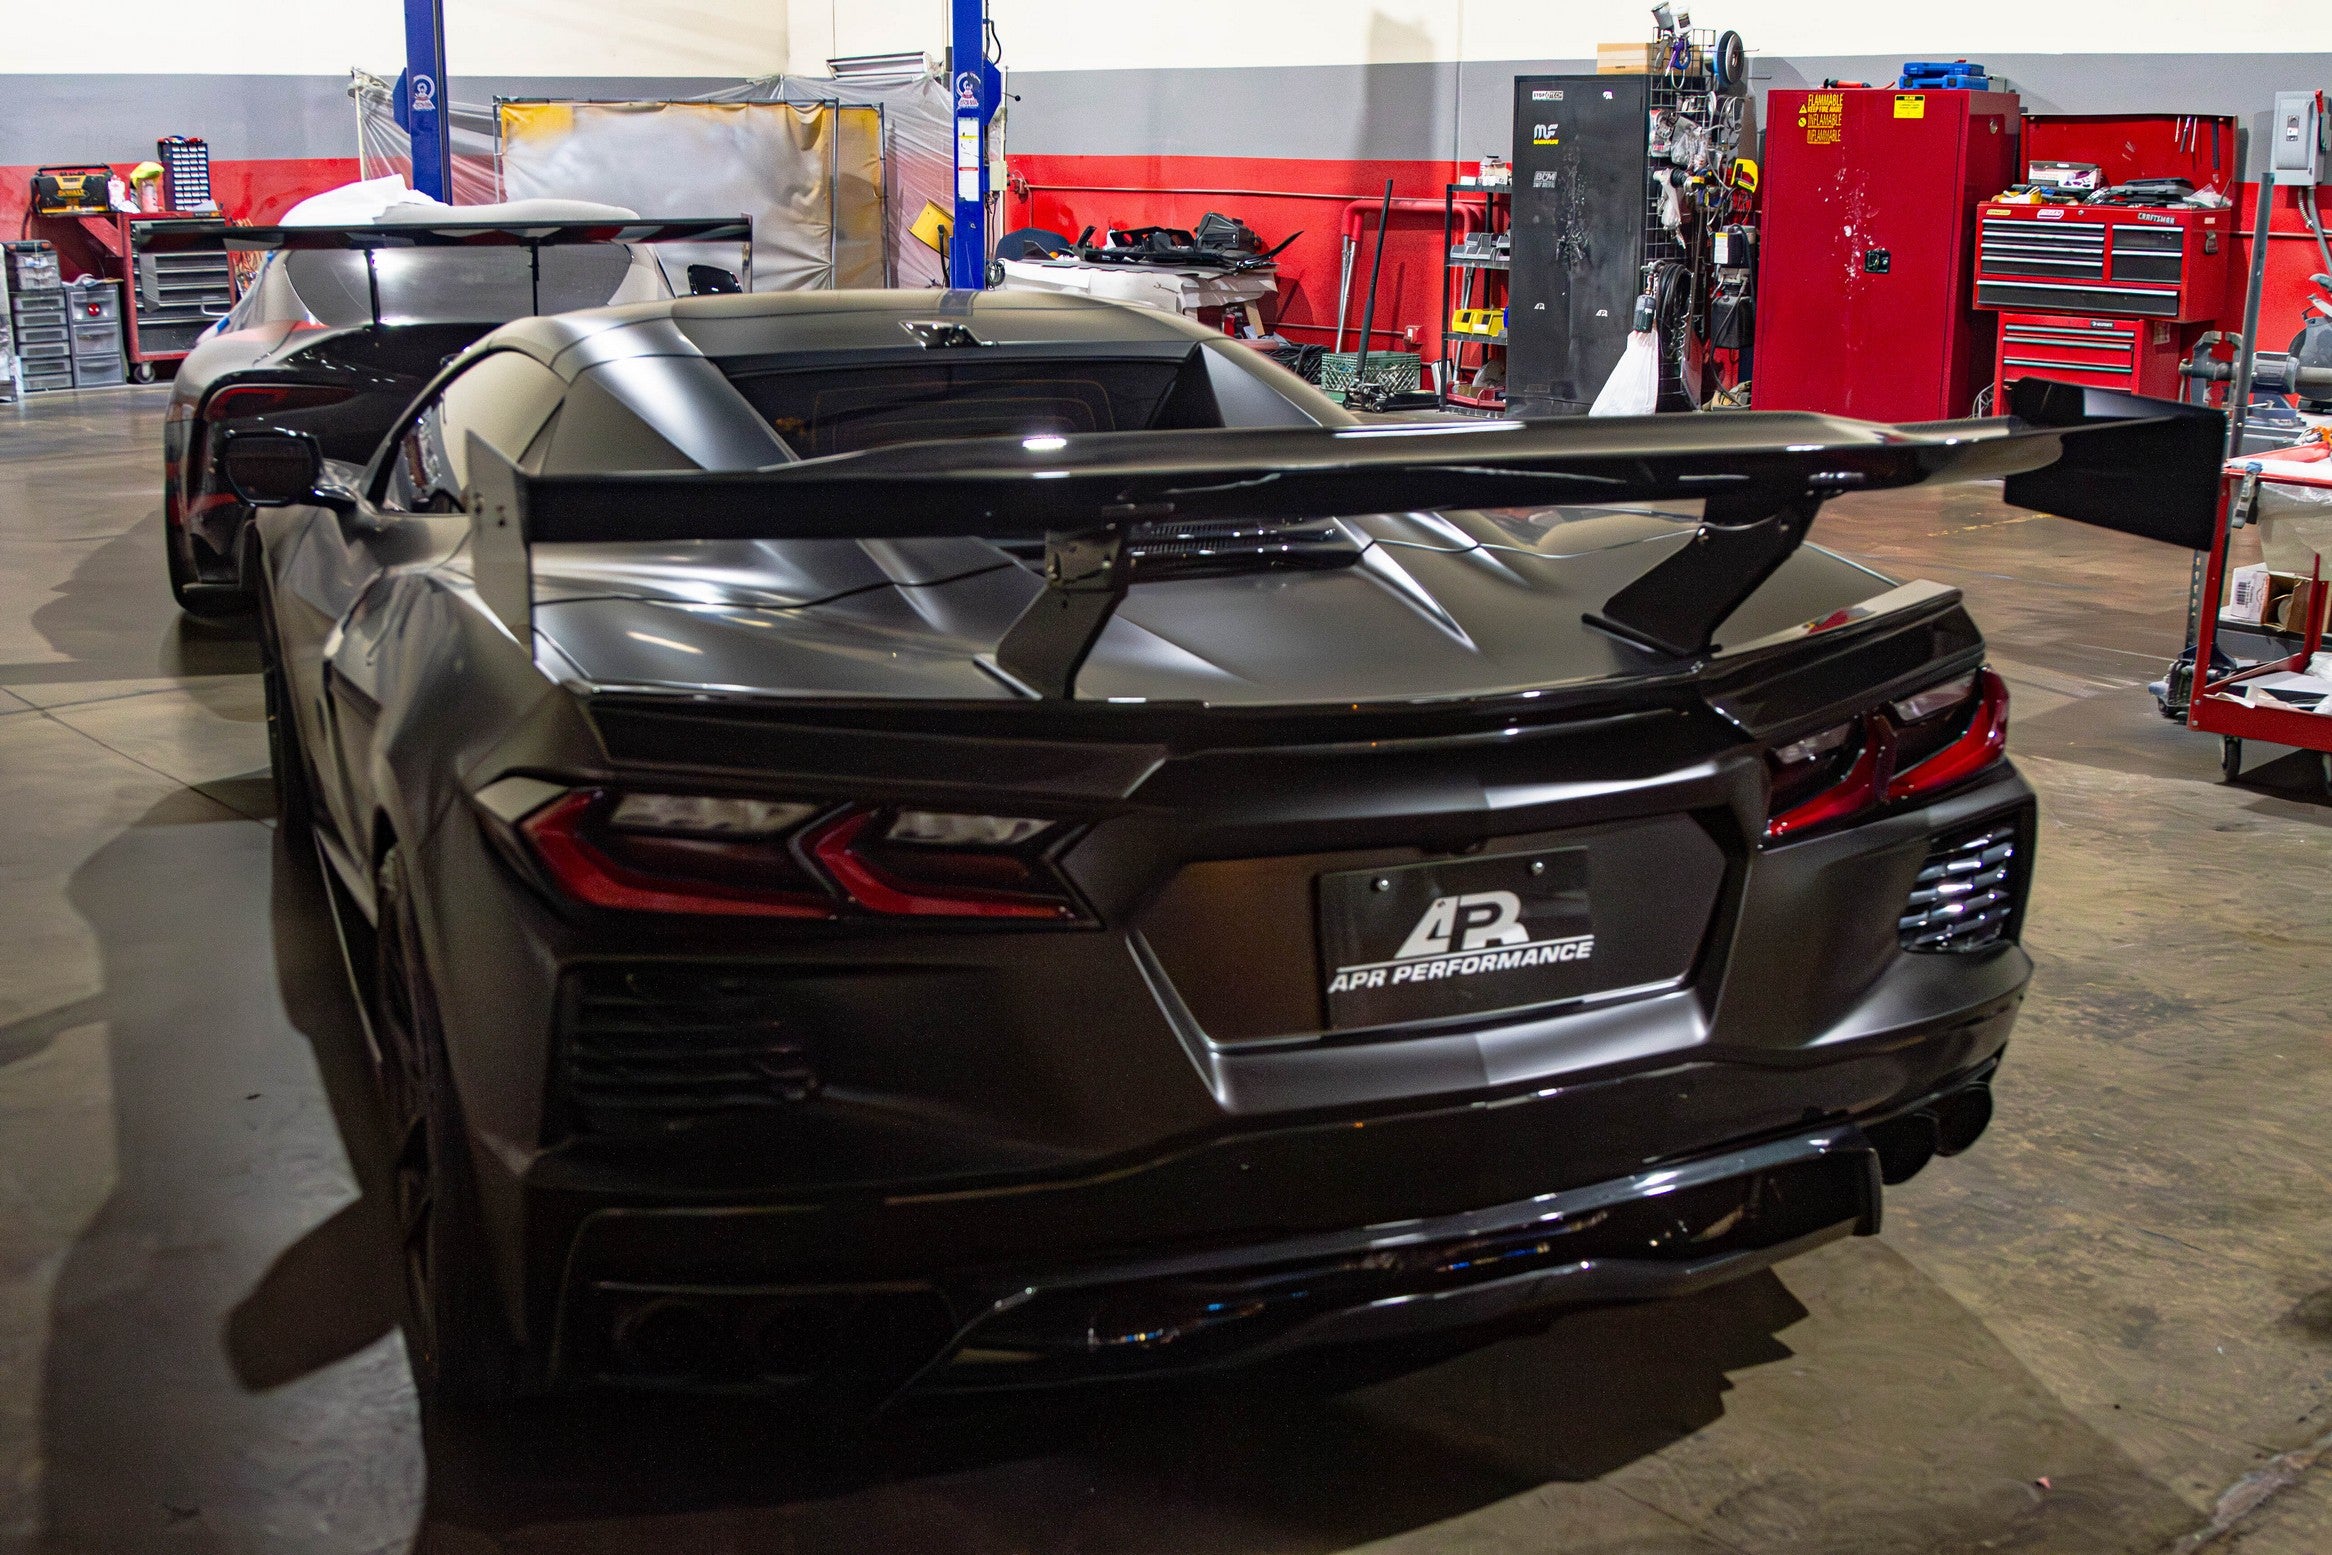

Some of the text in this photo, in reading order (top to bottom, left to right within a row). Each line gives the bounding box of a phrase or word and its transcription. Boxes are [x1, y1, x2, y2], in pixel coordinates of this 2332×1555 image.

[1808, 93, 1844, 106] FLAMMABLE
[2137, 212, 2175, 225] CRAFTSMAN
[1327, 940, 1595, 995] APR PERFORMANCE
